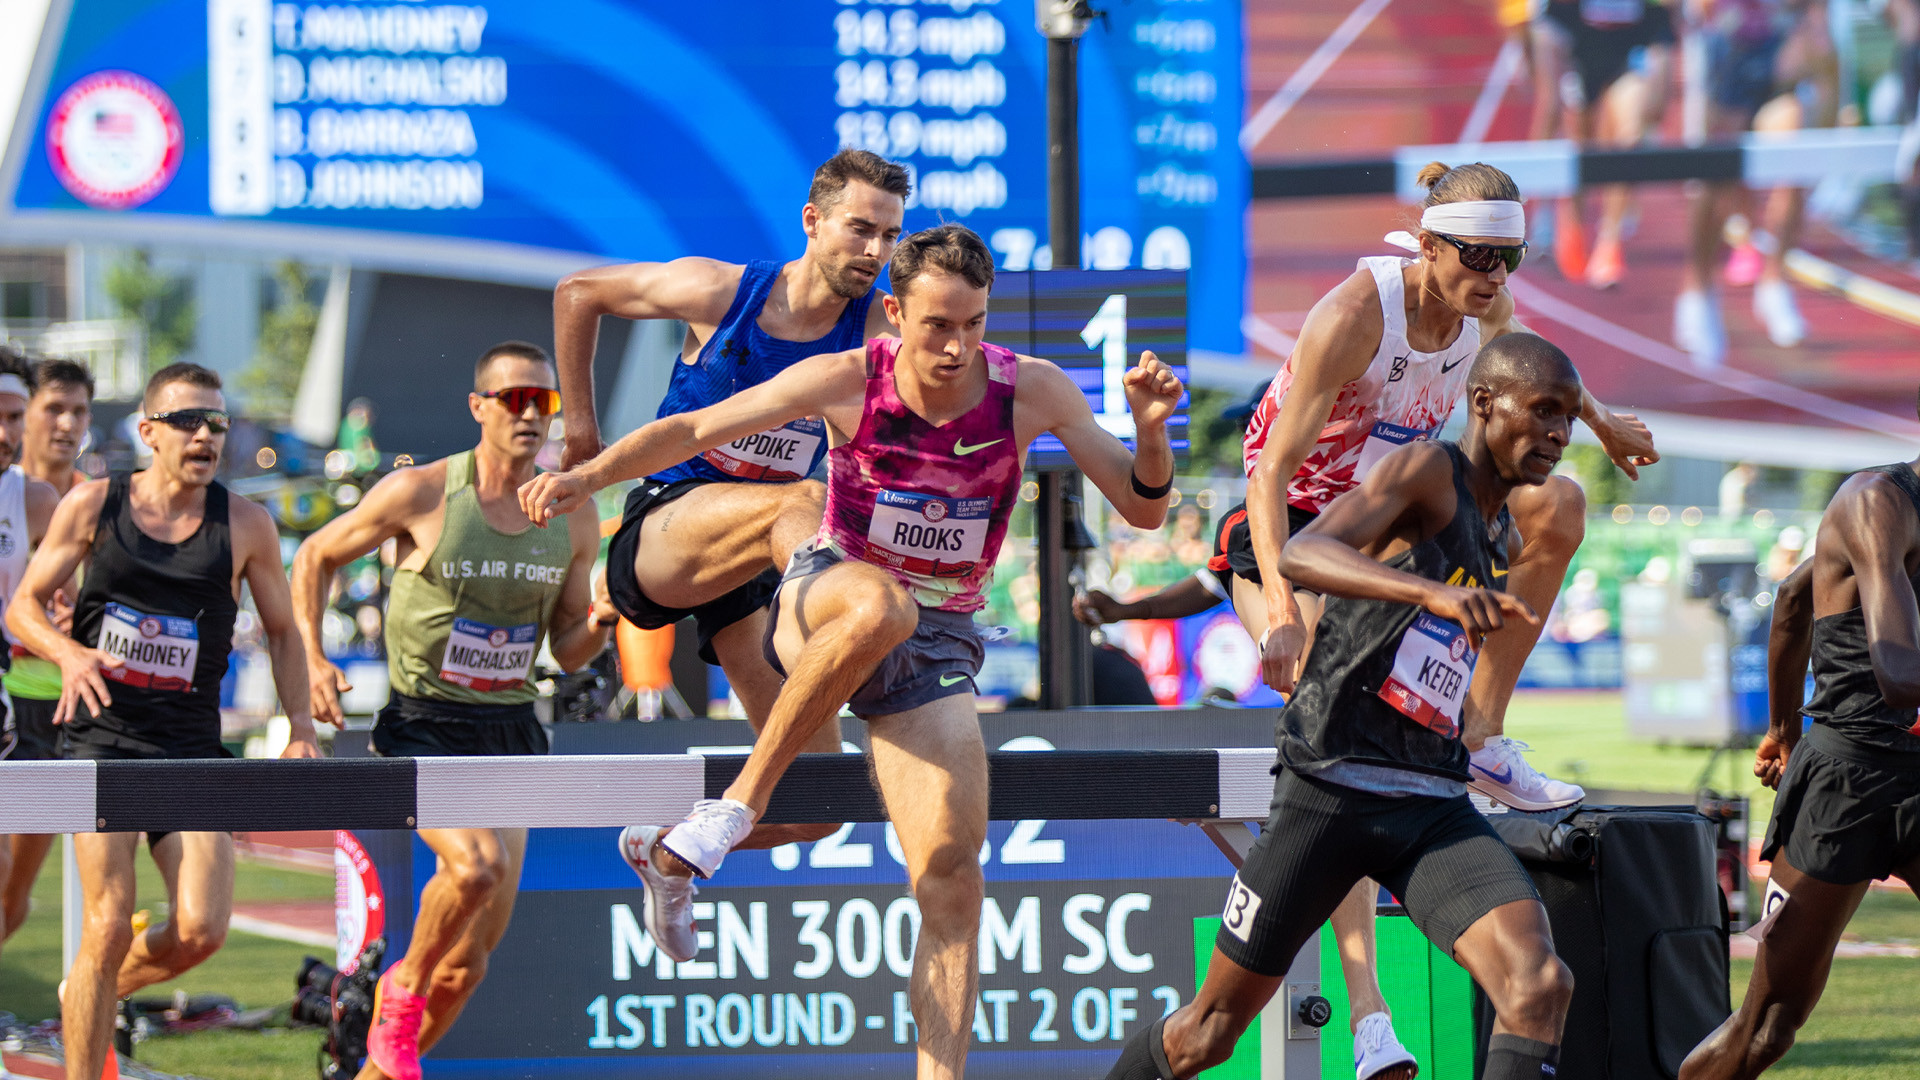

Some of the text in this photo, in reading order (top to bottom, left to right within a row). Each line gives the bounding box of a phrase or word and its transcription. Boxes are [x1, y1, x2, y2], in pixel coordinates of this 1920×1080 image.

[1079, 294, 1137, 438] 1
[893, 521, 965, 551] ROOKS
[442, 560, 565, 584] U.S. AIR FORCE
[103, 630, 191, 669] MAHONEY
[1427, 622, 1451, 637] USATF
[448, 644, 531, 671] MICHALSKI
[1416, 654, 1463, 702] KETER
[1225, 880, 1250, 929] 13
[611, 893, 1155, 981] MEN 300M SC
[586, 994, 677, 1050] 1ST
[684, 992, 858, 1048] ROUND
[893, 989, 1020, 1044] HAT
[1029, 987, 1060, 1042] 2
[1071, 986, 1139, 1042] OF
